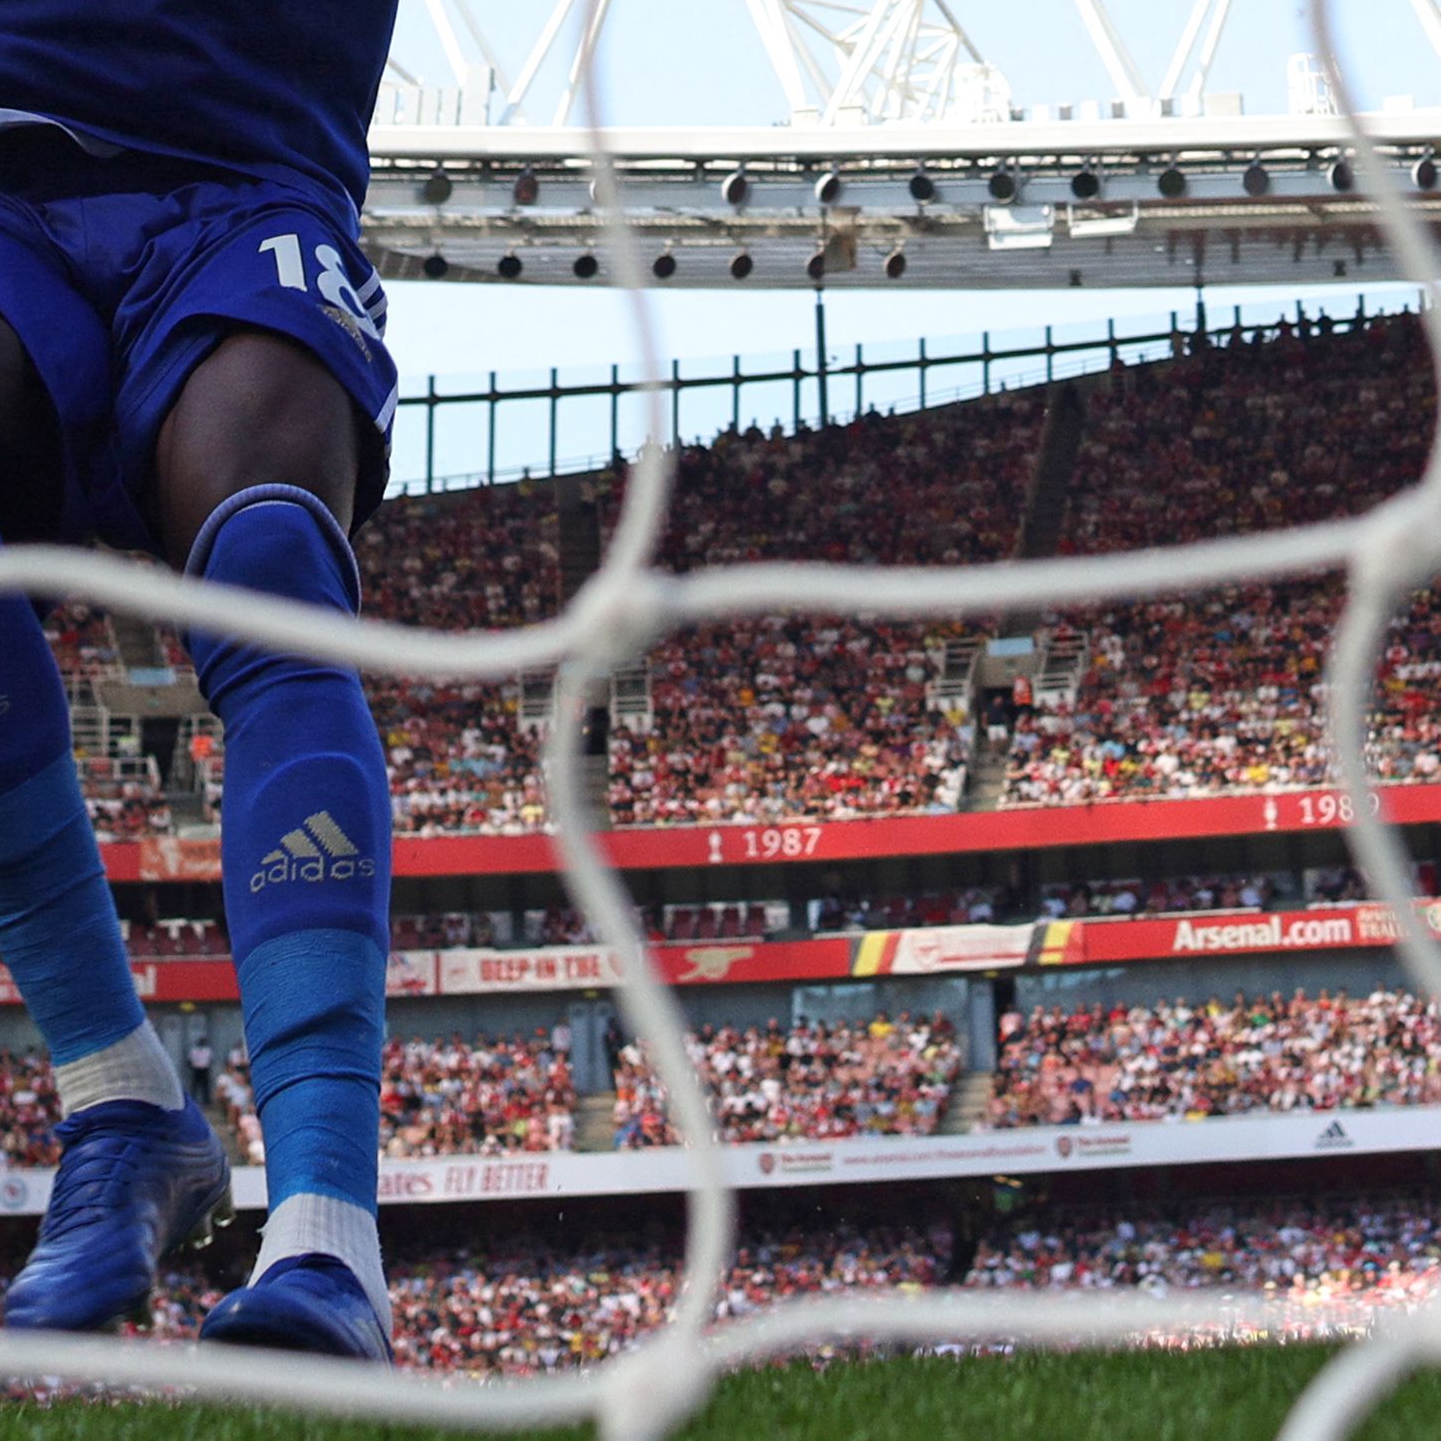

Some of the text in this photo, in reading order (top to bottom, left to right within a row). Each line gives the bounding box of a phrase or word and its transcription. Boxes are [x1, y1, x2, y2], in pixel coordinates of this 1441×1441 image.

[258, 233, 382, 342] 18
[742, 827, 823, 859] 1987
[250, 855, 376, 894] adidas
[1173, 916, 1352, 951] Arsenal.com
